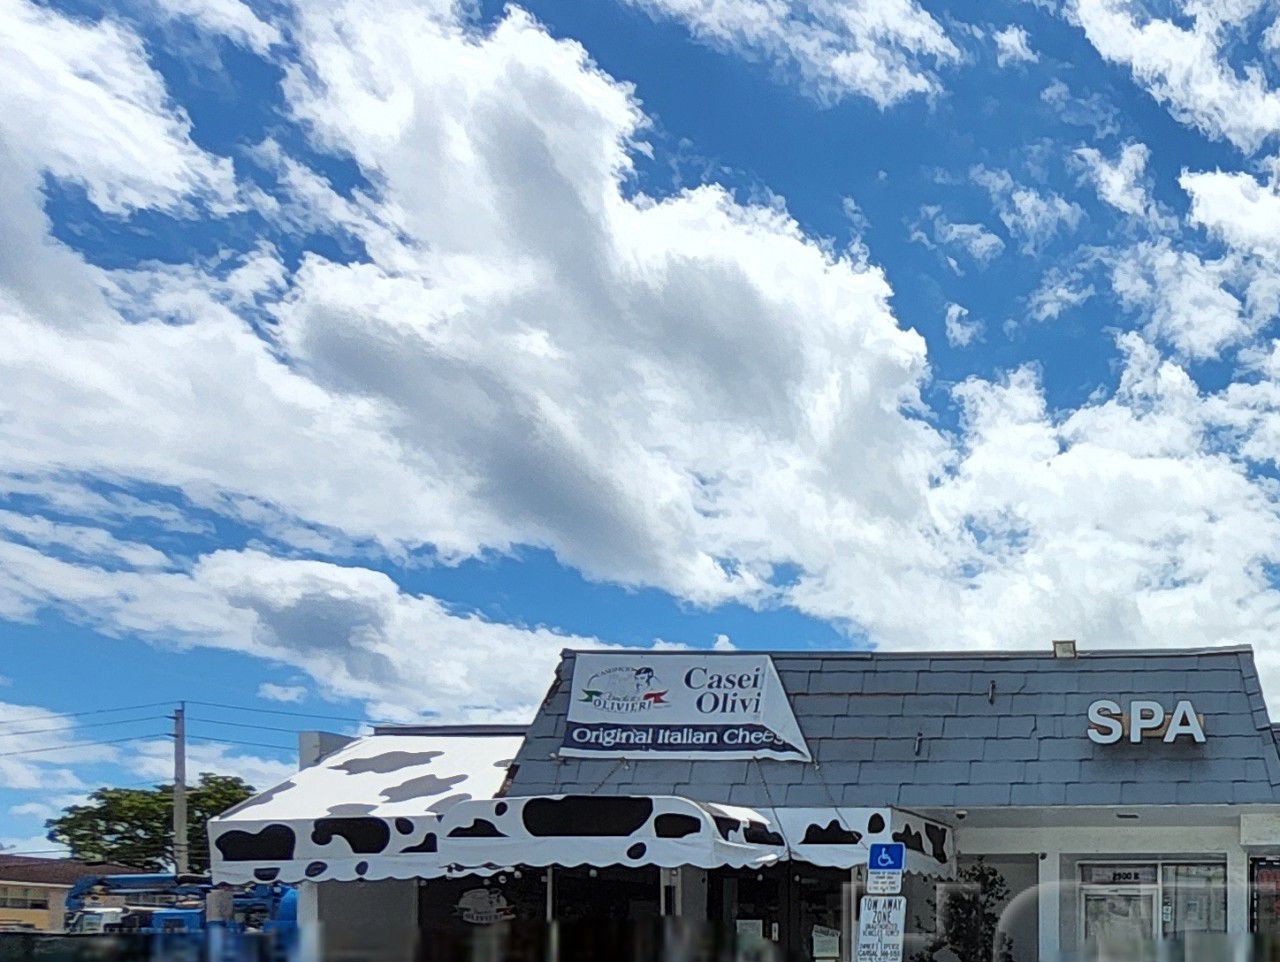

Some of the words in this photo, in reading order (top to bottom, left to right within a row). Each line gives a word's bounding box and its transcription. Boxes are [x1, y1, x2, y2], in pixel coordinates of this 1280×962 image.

[683, 667, 761, 690] Casei
[695, 691, 762, 714] Olivi
[1087, 699, 1207, 745] SPA
[572, 727, 653, 746] Original
[656, 728, 718, 744] Italian
[864, 898, 878, 911] TOW
[882, 898, 902, 911] AWAY
[873, 911, 892, 924] ZONE
